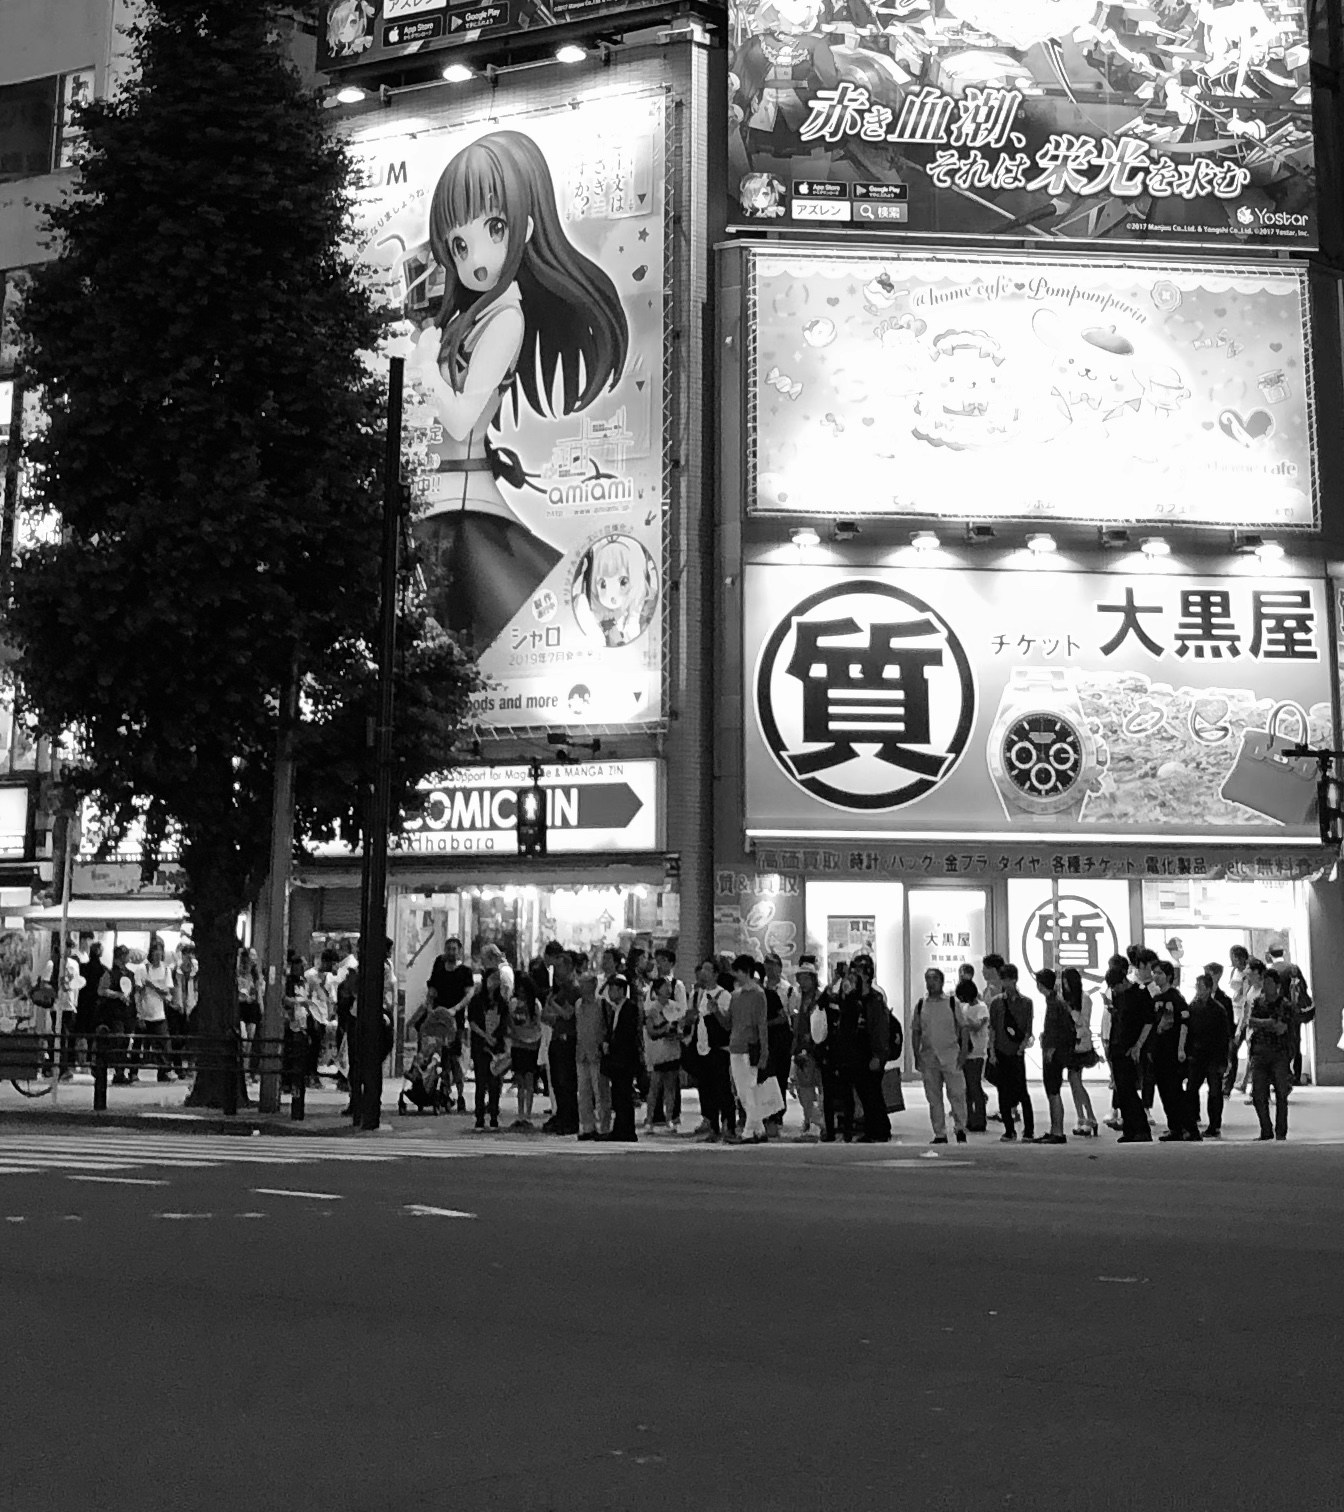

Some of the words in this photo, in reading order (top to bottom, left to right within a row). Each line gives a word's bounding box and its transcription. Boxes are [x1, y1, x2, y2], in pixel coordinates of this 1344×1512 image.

[464, 10, 486, 23] Google
[487, 7, 501, 20] Play
[417, 21, 435, 33] Store
[924, 133, 1253, 201] それは栄光を求む
[796, 203, 841, 217] アズレン
[877, 206, 901, 219] 検索
[1253, 207, 1309, 227] Yostar
[1028, 276, 1148, 326] Pompompurin
[547, 478, 633, 507] amiami
[1096, 587, 1320, 662] 大黒屋
[511, 625, 562, 650] シャロ
[989, 633, 1082, 658] チケット
[499, 693, 522, 711] and
[525, 695, 560, 709] more
[782, 614, 955, 782] 質
[564, 765, 604, 778] MANGA
[760, 851, 841, 871] 高価買取
[849, 854, 880, 872] 時計
[1145, 856, 1207, 876] 電化製品
[925, 931, 971, 947] 大黒屋
